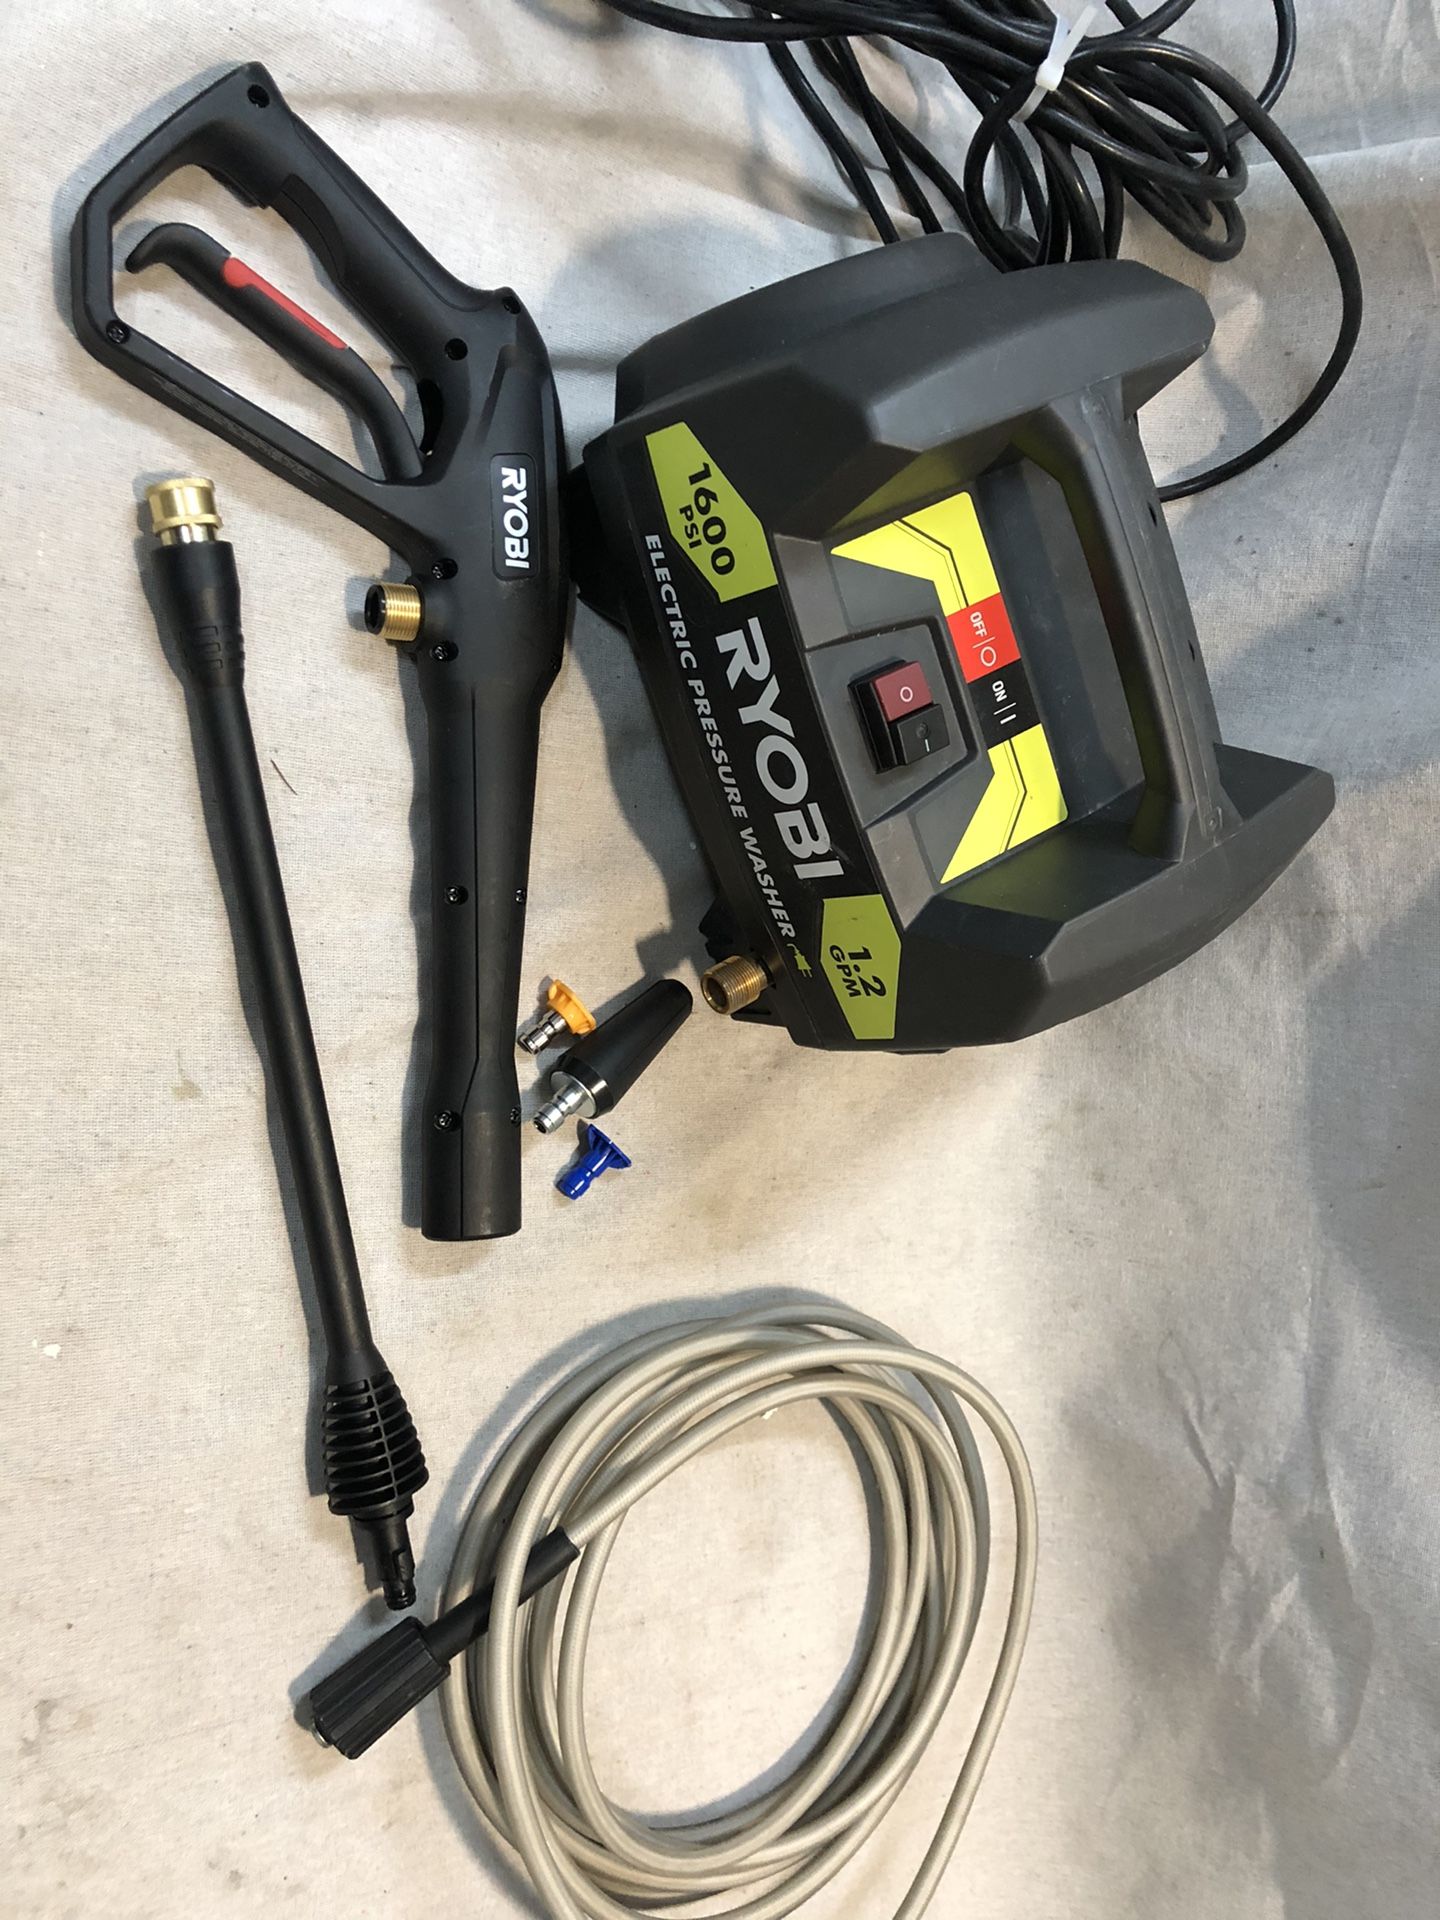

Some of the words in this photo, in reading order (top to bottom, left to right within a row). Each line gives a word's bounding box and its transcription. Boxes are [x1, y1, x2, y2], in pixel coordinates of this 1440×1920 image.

[501, 467, 530, 569] RYOBI
[679, 505, 702, 548] PSI
[688, 462, 735, 576] 1600
[969, 611, 988, 637] OFF
[992, 680, 1008, 703] ON
[645, 534, 697, 670] ELECTRIC
[687, 679, 748, 819] PRESSURE
[739, 826, 795, 938] WASHER
[715, 616, 844, 879] RYOBI
[828, 944, 862, 998] GPM
[848, 945, 887, 998] 1.2
